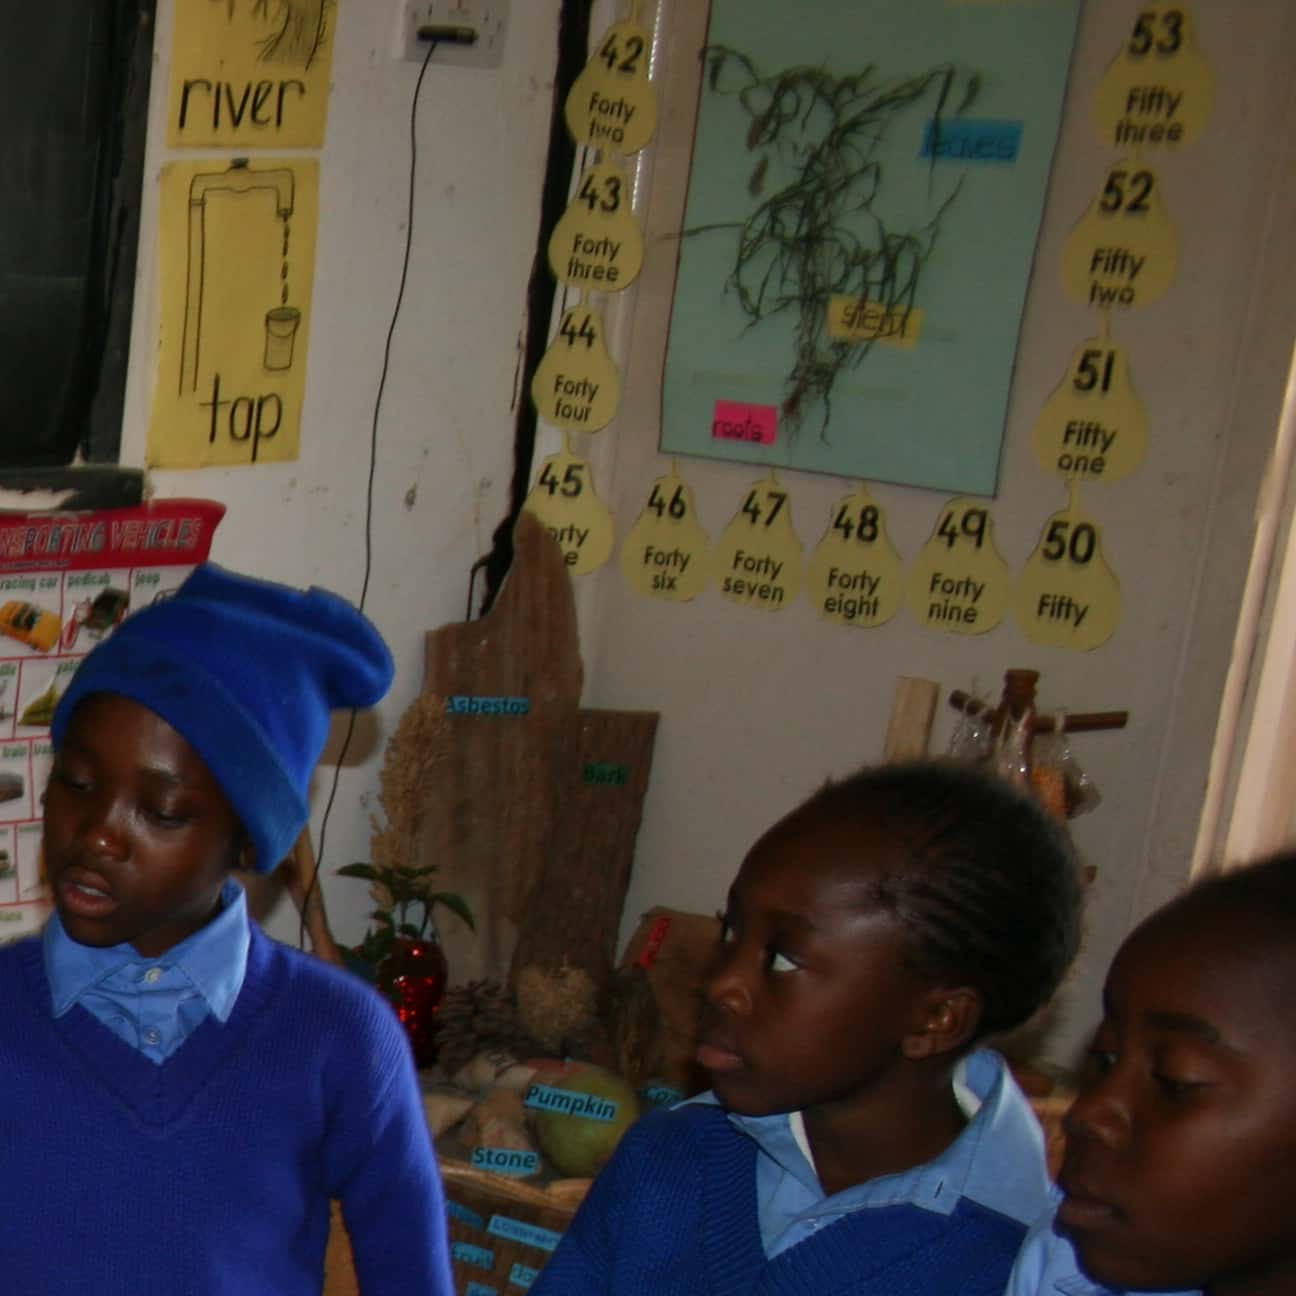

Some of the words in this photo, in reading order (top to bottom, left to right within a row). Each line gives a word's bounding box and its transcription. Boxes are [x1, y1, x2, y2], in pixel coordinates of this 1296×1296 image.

[1128, 10, 1183, 58] 53
[600, 33, 643, 72] 42
[179, 79, 306, 130] river
[589, 91, 636, 124] Forty
[1126, 86, 1183, 117] Fifty
[589, 118, 625, 143] two
[1115, 118, 1182, 147] three
[578, 173, 621, 212] 43
[1099, 170, 1153, 213] 52
[573, 233, 622, 261] Forty
[567, 256, 619, 281] three
[1089, 248, 1145, 280] Fifty
[1088, 280, 1135, 306] two
[560, 312, 595, 348] 44
[554, 374, 599, 401] Forty
[1073, 350, 1115, 393] 51
[200, 373, 283, 463] tap
[555, 400, 591, 422] four
[1062, 421, 1117, 453] Fifty
[1058, 453, 1105, 474] one
[538, 463, 584, 497] 45
[647, 484, 686, 519] 46
[742, 489, 788, 527] 47
[110, 517, 204, 551] VEHICLES
[549, 524, 589, 547] orty
[833, 504, 879, 541] 48
[937, 508, 988, 549] 49
[1042, 520, 1096, 565] 50
[644, 546, 690, 572] Forty
[733, 550, 784, 581] Forty
[652, 571, 677, 590] six
[723, 576, 784, 602] seven
[827, 568, 881, 596] Forty
[930, 572, 986, 602] Forty
[824, 595, 879, 619] eight
[928, 600, 977, 623] nine
[1037, 594, 1089, 627] Fifty
[528, 1084, 616, 1119] Pumpkin
[473, 1148, 537, 1169] Stone
